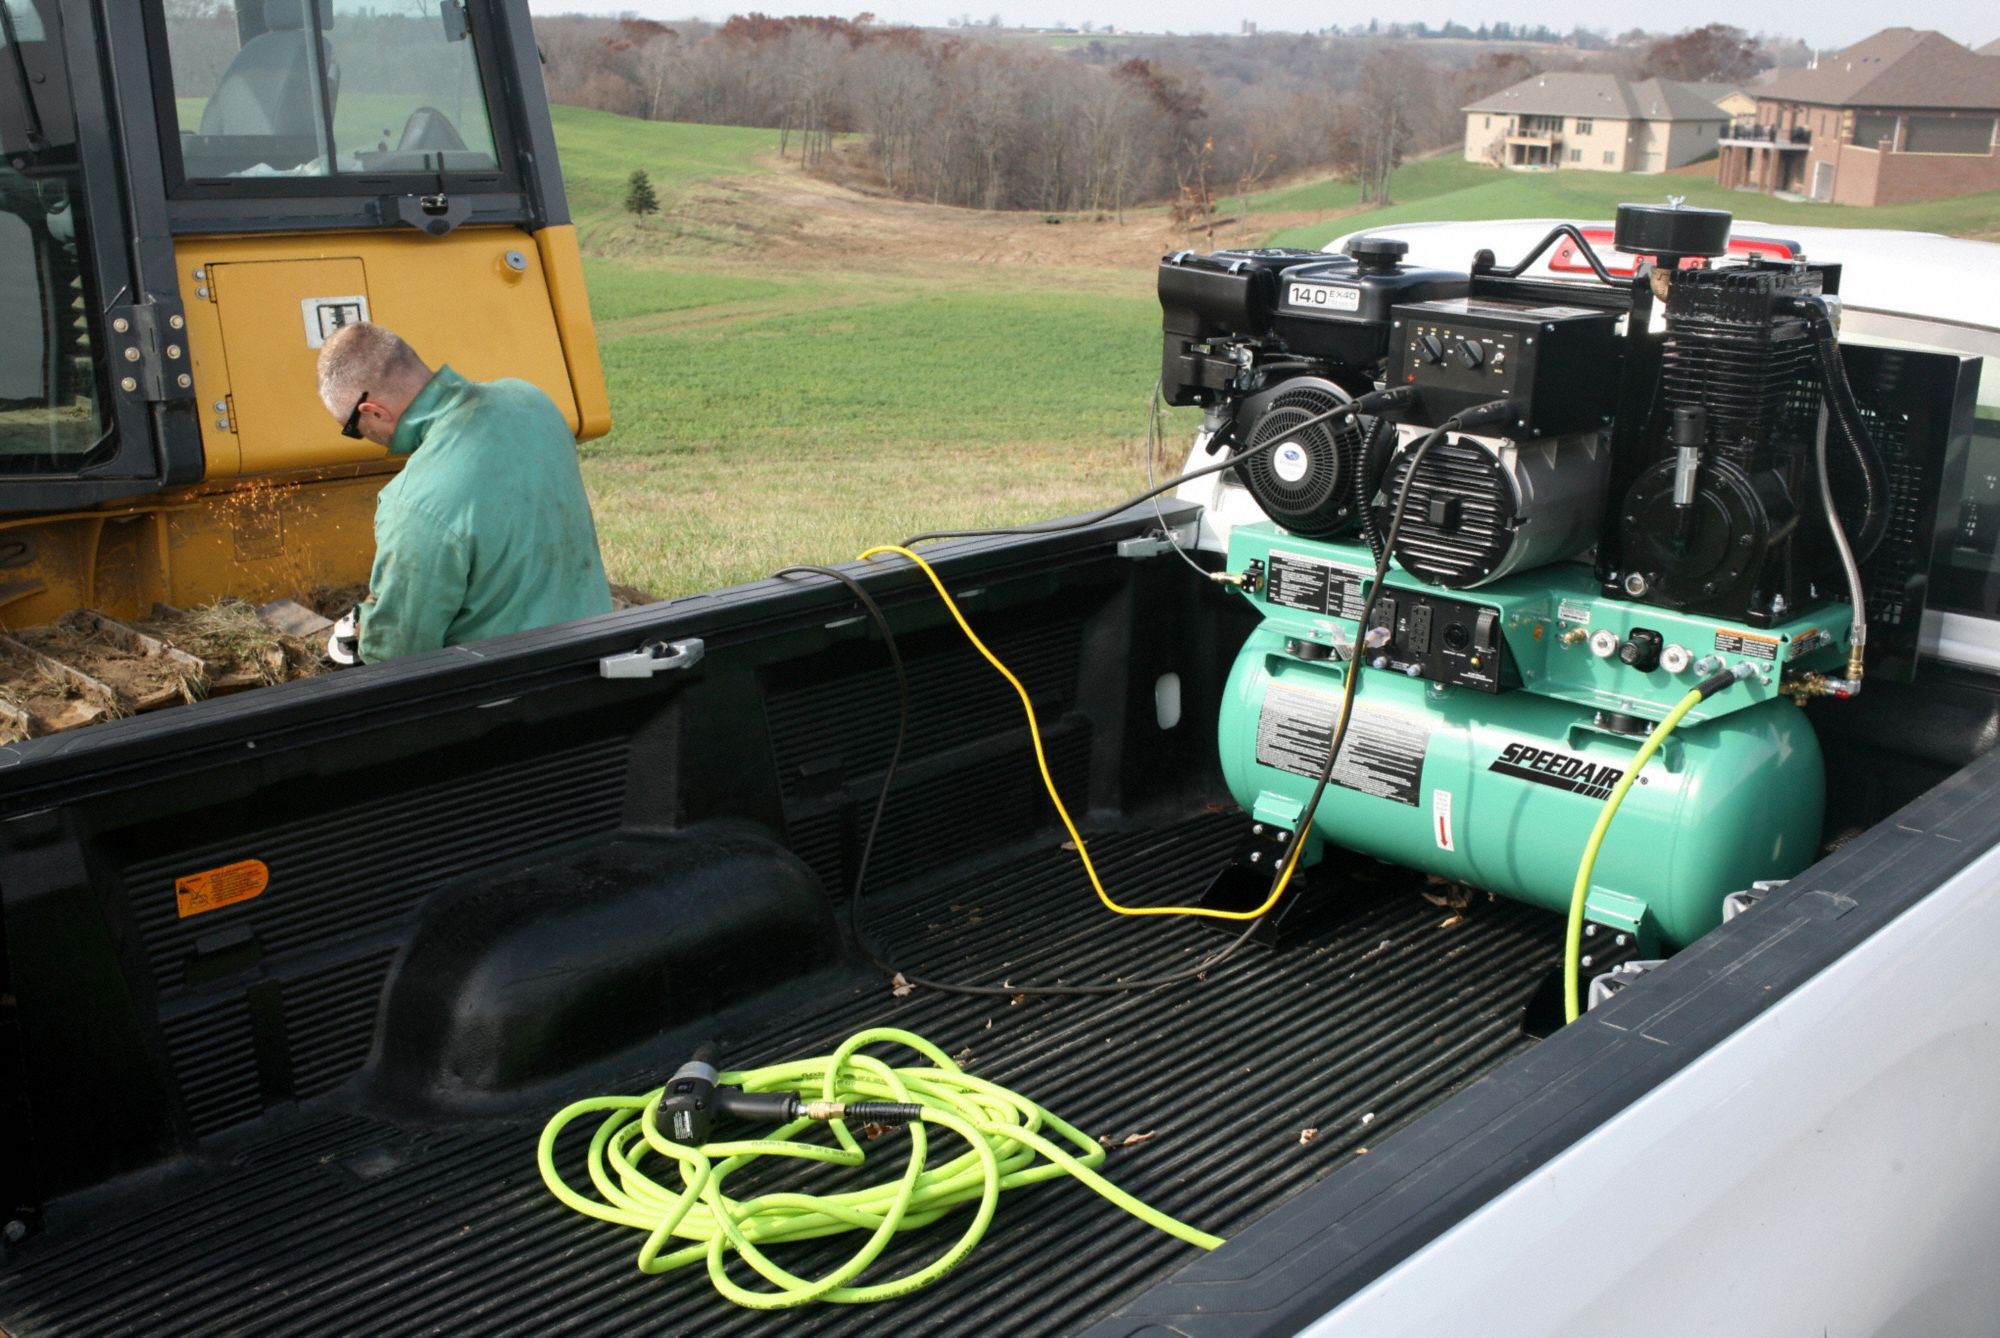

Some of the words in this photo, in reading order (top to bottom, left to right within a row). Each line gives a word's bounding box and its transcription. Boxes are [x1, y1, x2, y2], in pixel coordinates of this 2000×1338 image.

[1292, 288, 1327, 304] 14.0
[1329, 290, 1356, 300] EX40
[1497, 742, 1639, 789] SPEEDAIR
